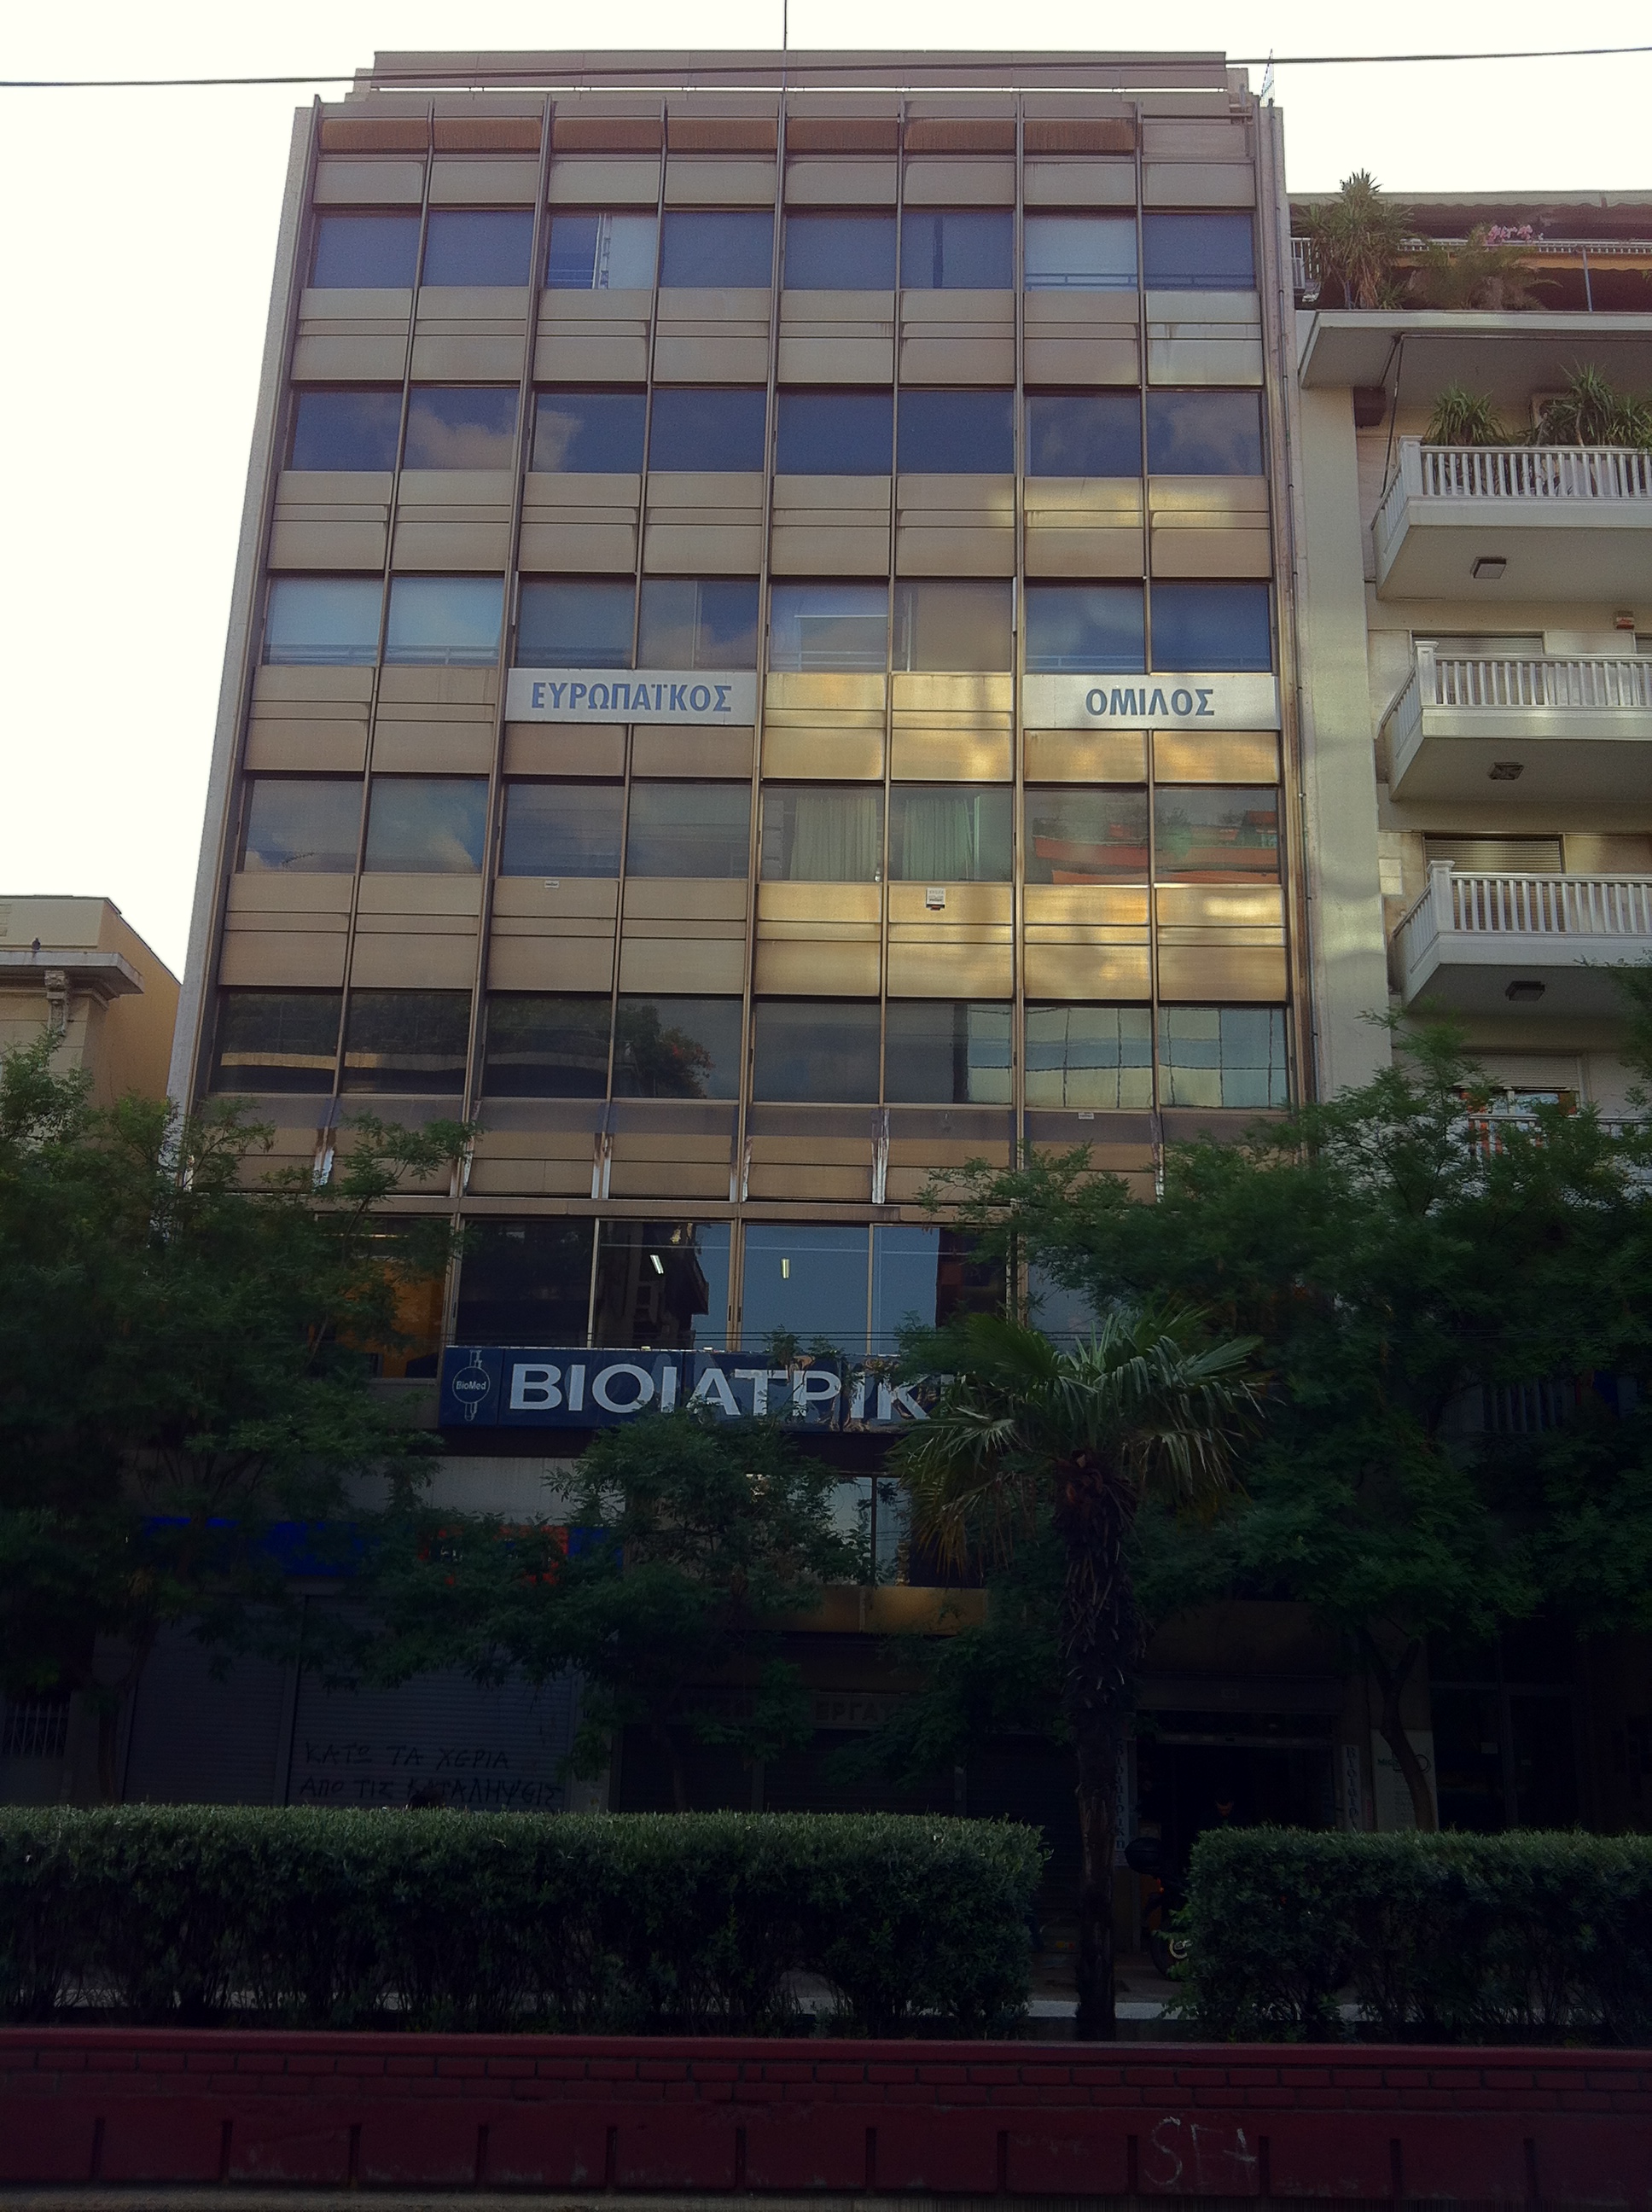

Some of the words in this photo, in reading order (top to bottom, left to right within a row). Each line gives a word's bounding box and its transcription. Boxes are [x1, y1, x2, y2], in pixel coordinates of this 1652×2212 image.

[531, 682, 732, 712] ΕΥΡΩΠΑΪΚΟΣ
[1085, 688, 1215, 716] ΟΜΙΛΟΣ
[456, 1380, 486, 1390] BioMed
[509, 1362, 956, 1420] ΒΙΟΙΑΤΡΙΚ
